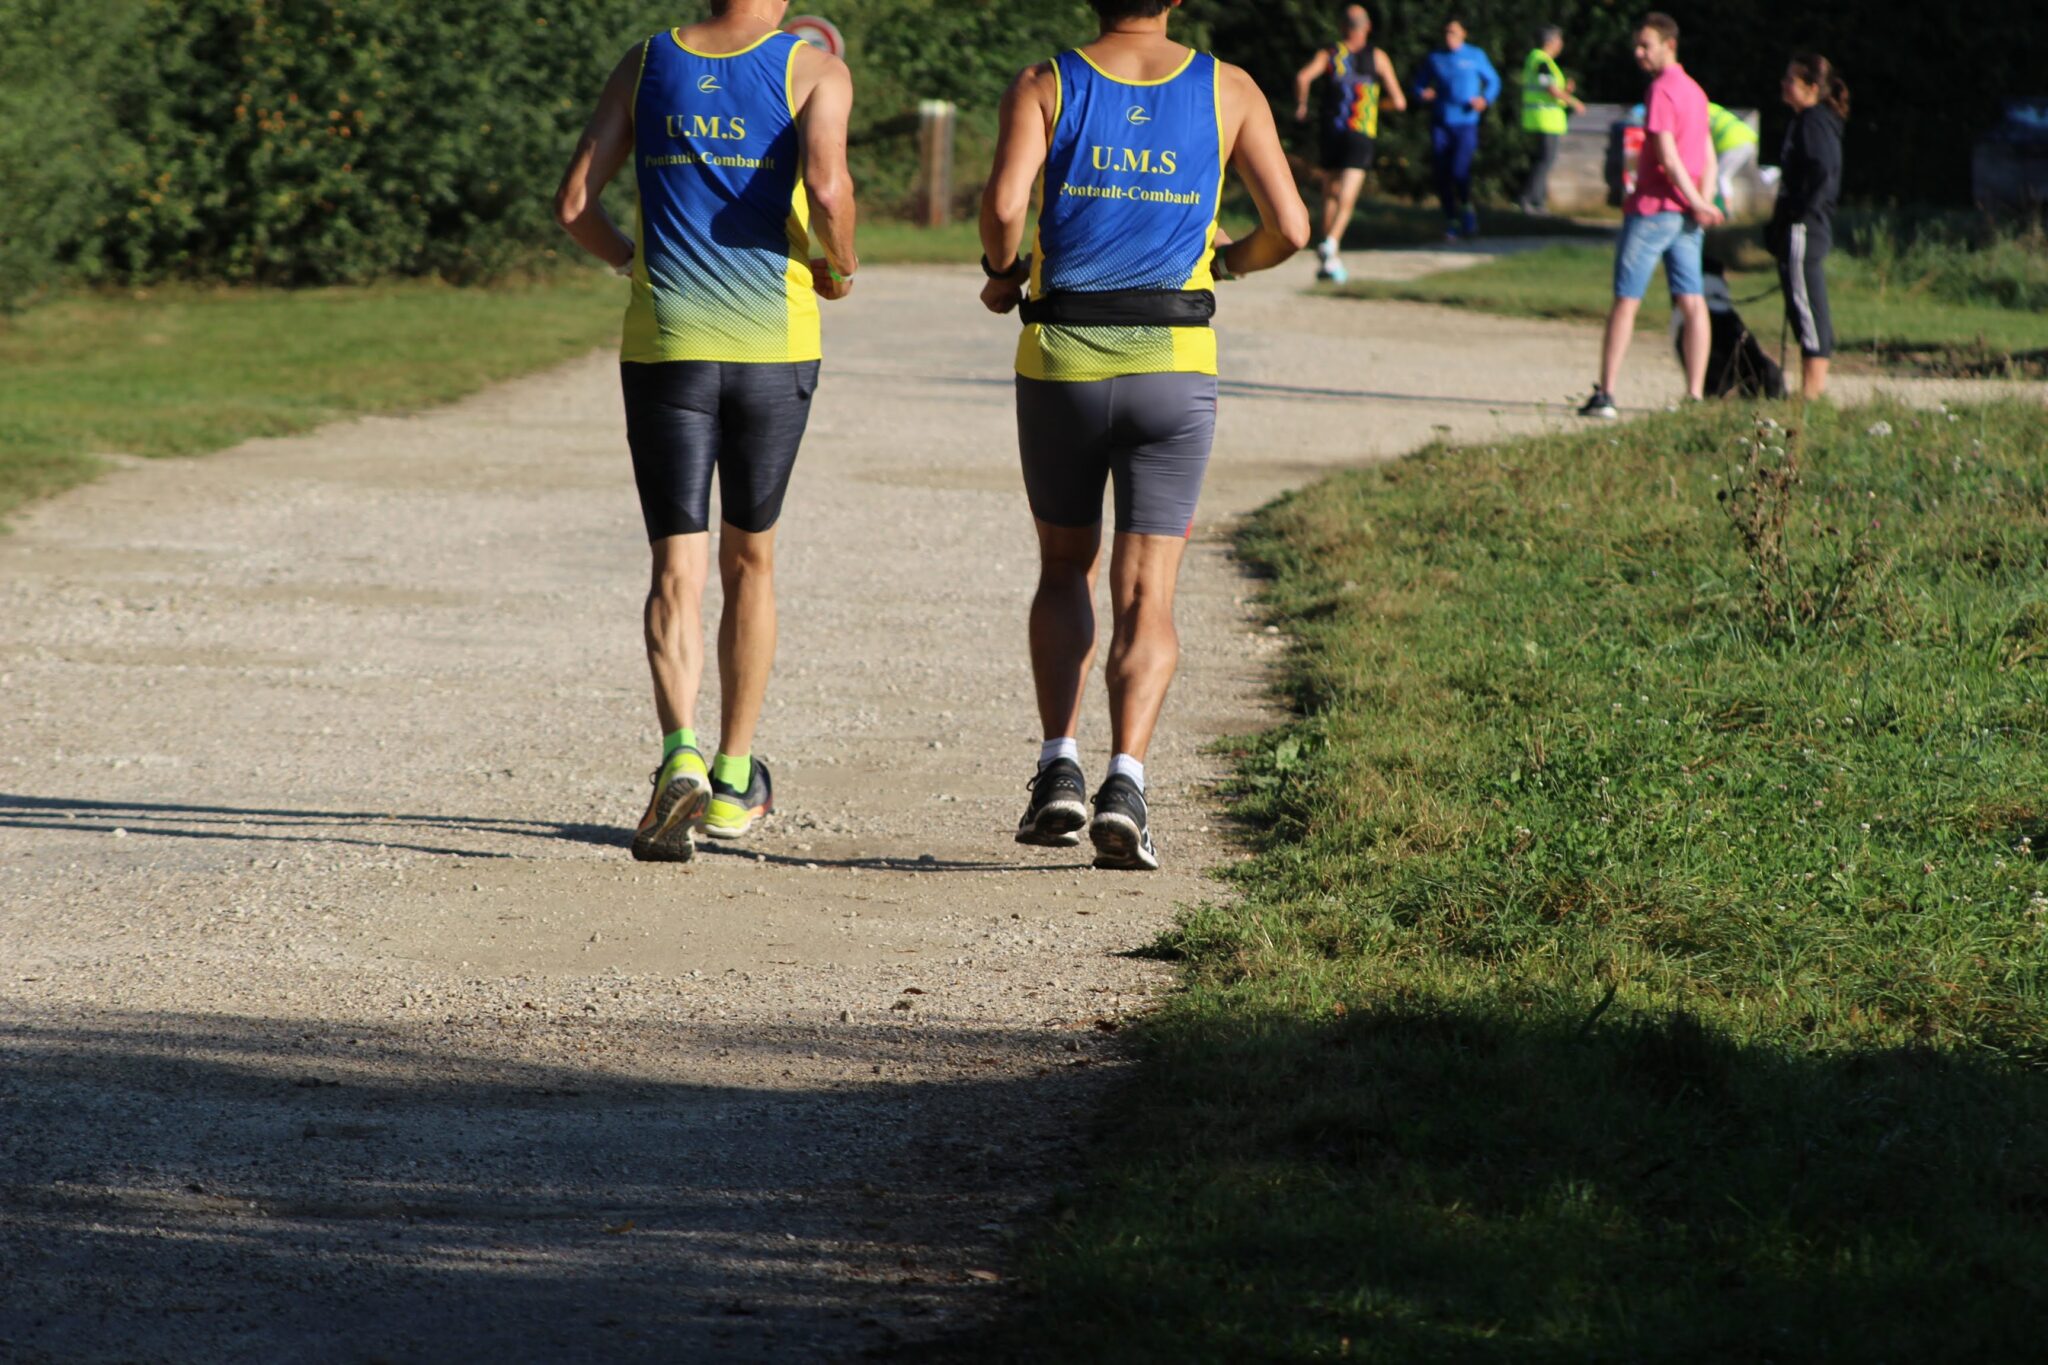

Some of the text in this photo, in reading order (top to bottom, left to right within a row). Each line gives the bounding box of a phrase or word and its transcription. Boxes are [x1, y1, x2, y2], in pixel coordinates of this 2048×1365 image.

[666, 114, 746, 140] U.M.S
[1092, 145, 1177, 175] U.M.S
[1059, 182, 1201, 205] Pontault-Combault
